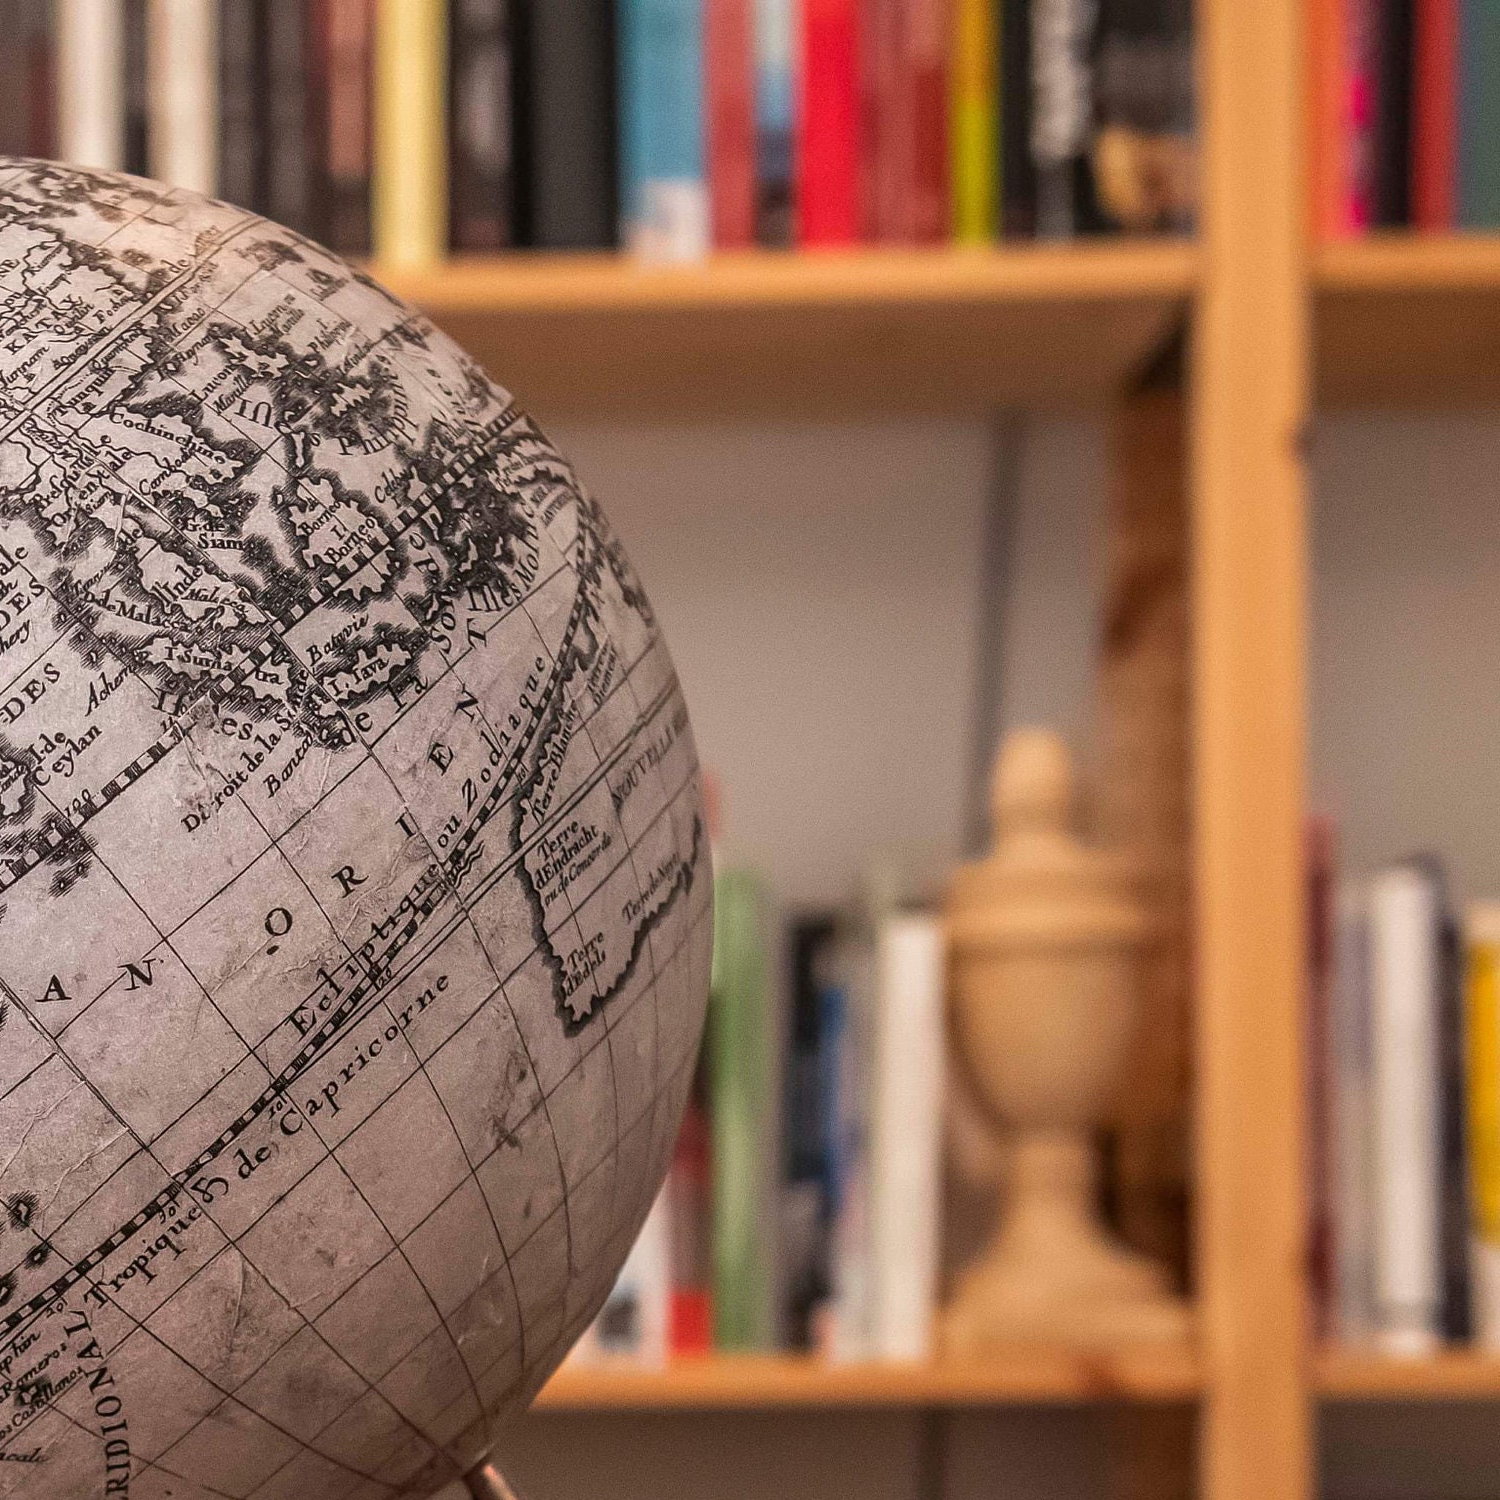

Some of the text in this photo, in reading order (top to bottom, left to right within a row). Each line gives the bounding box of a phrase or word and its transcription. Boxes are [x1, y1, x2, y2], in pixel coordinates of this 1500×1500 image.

[324, 515, 376, 563] Borneo
[462, 655, 546, 814] Zodiaque
[84, 974, 450, 1310] Tropique de Capricorne
